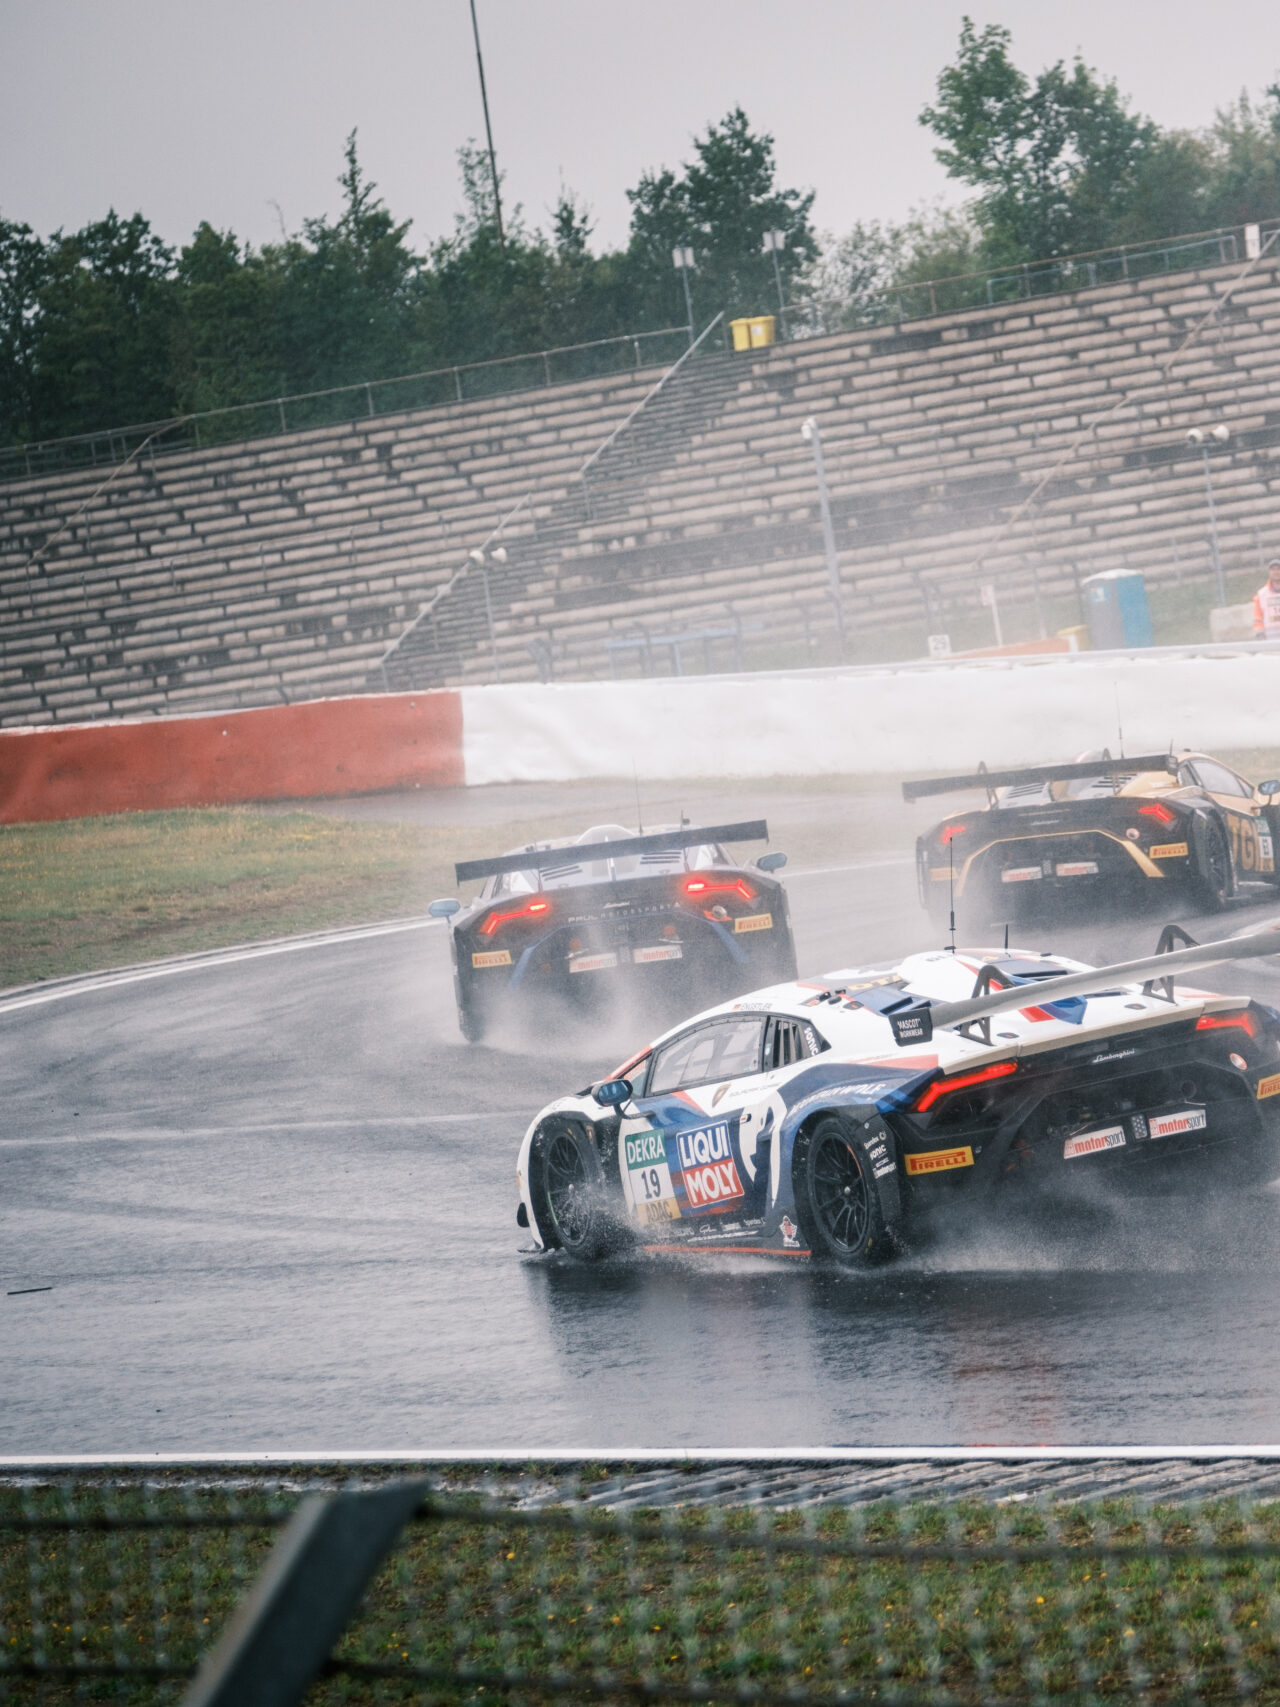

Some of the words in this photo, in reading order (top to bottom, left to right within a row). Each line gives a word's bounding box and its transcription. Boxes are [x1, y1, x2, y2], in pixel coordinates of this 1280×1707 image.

[1091, 1048, 1136, 1064] Lamborghini
[1158, 1113, 1206, 1135] motorsport
[627, 1132, 666, 1165] DEKRA
[678, 1125, 730, 1167] LIQUI
[1073, 1130, 1126, 1154] motorsport
[909, 1151, 967, 1172] PIRELLI
[640, 1168, 662, 1200] 19
[685, 1162, 742, 1204] MOLY
